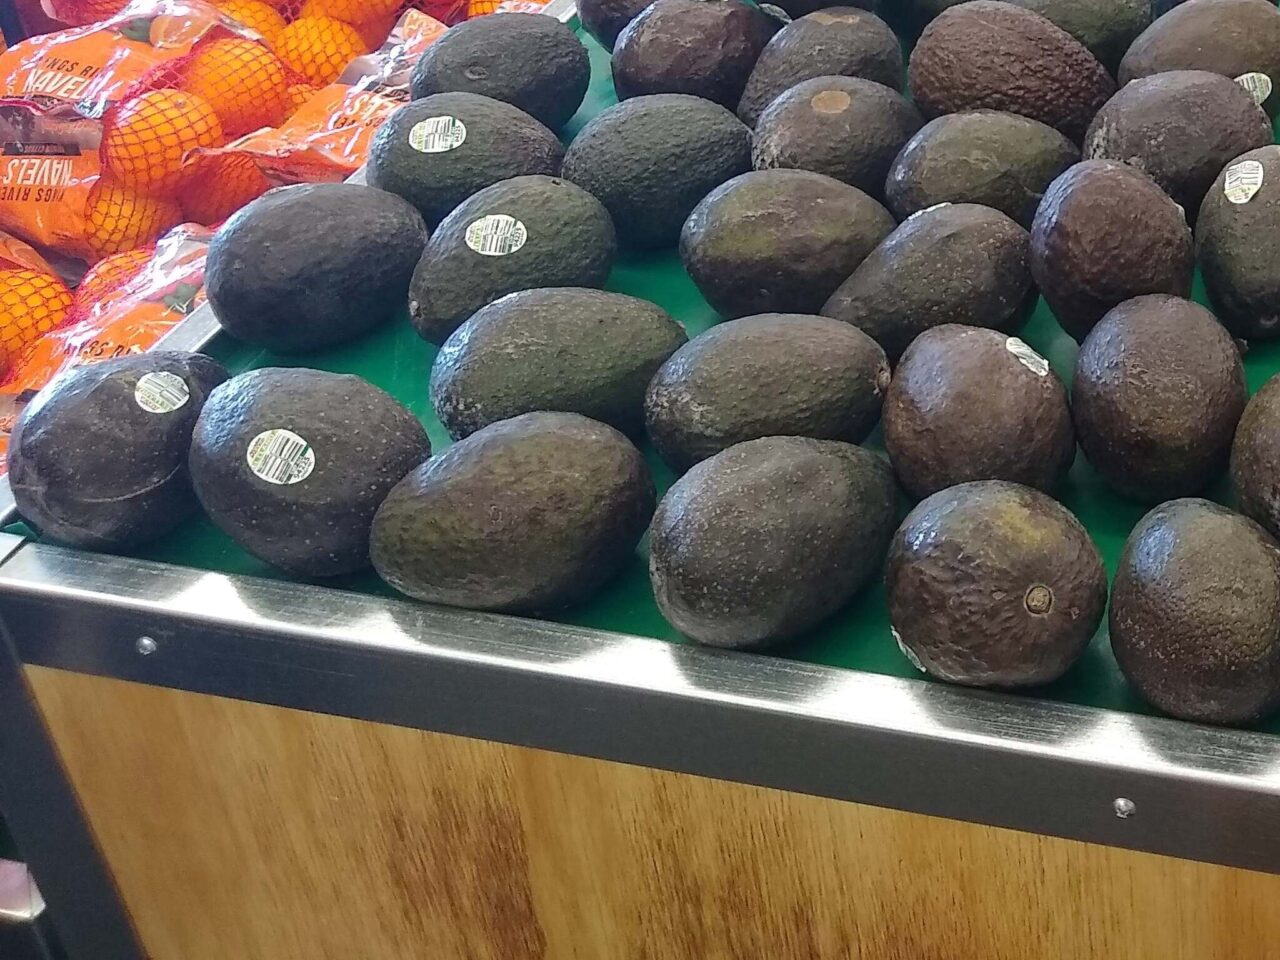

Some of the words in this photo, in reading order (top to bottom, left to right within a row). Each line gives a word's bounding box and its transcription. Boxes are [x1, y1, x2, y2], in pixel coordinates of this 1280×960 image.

[22, 69, 90, 100] NAVEL
[3, 158, 73, 186] NAVELS
[1, 186, 29, 201] RIVE
